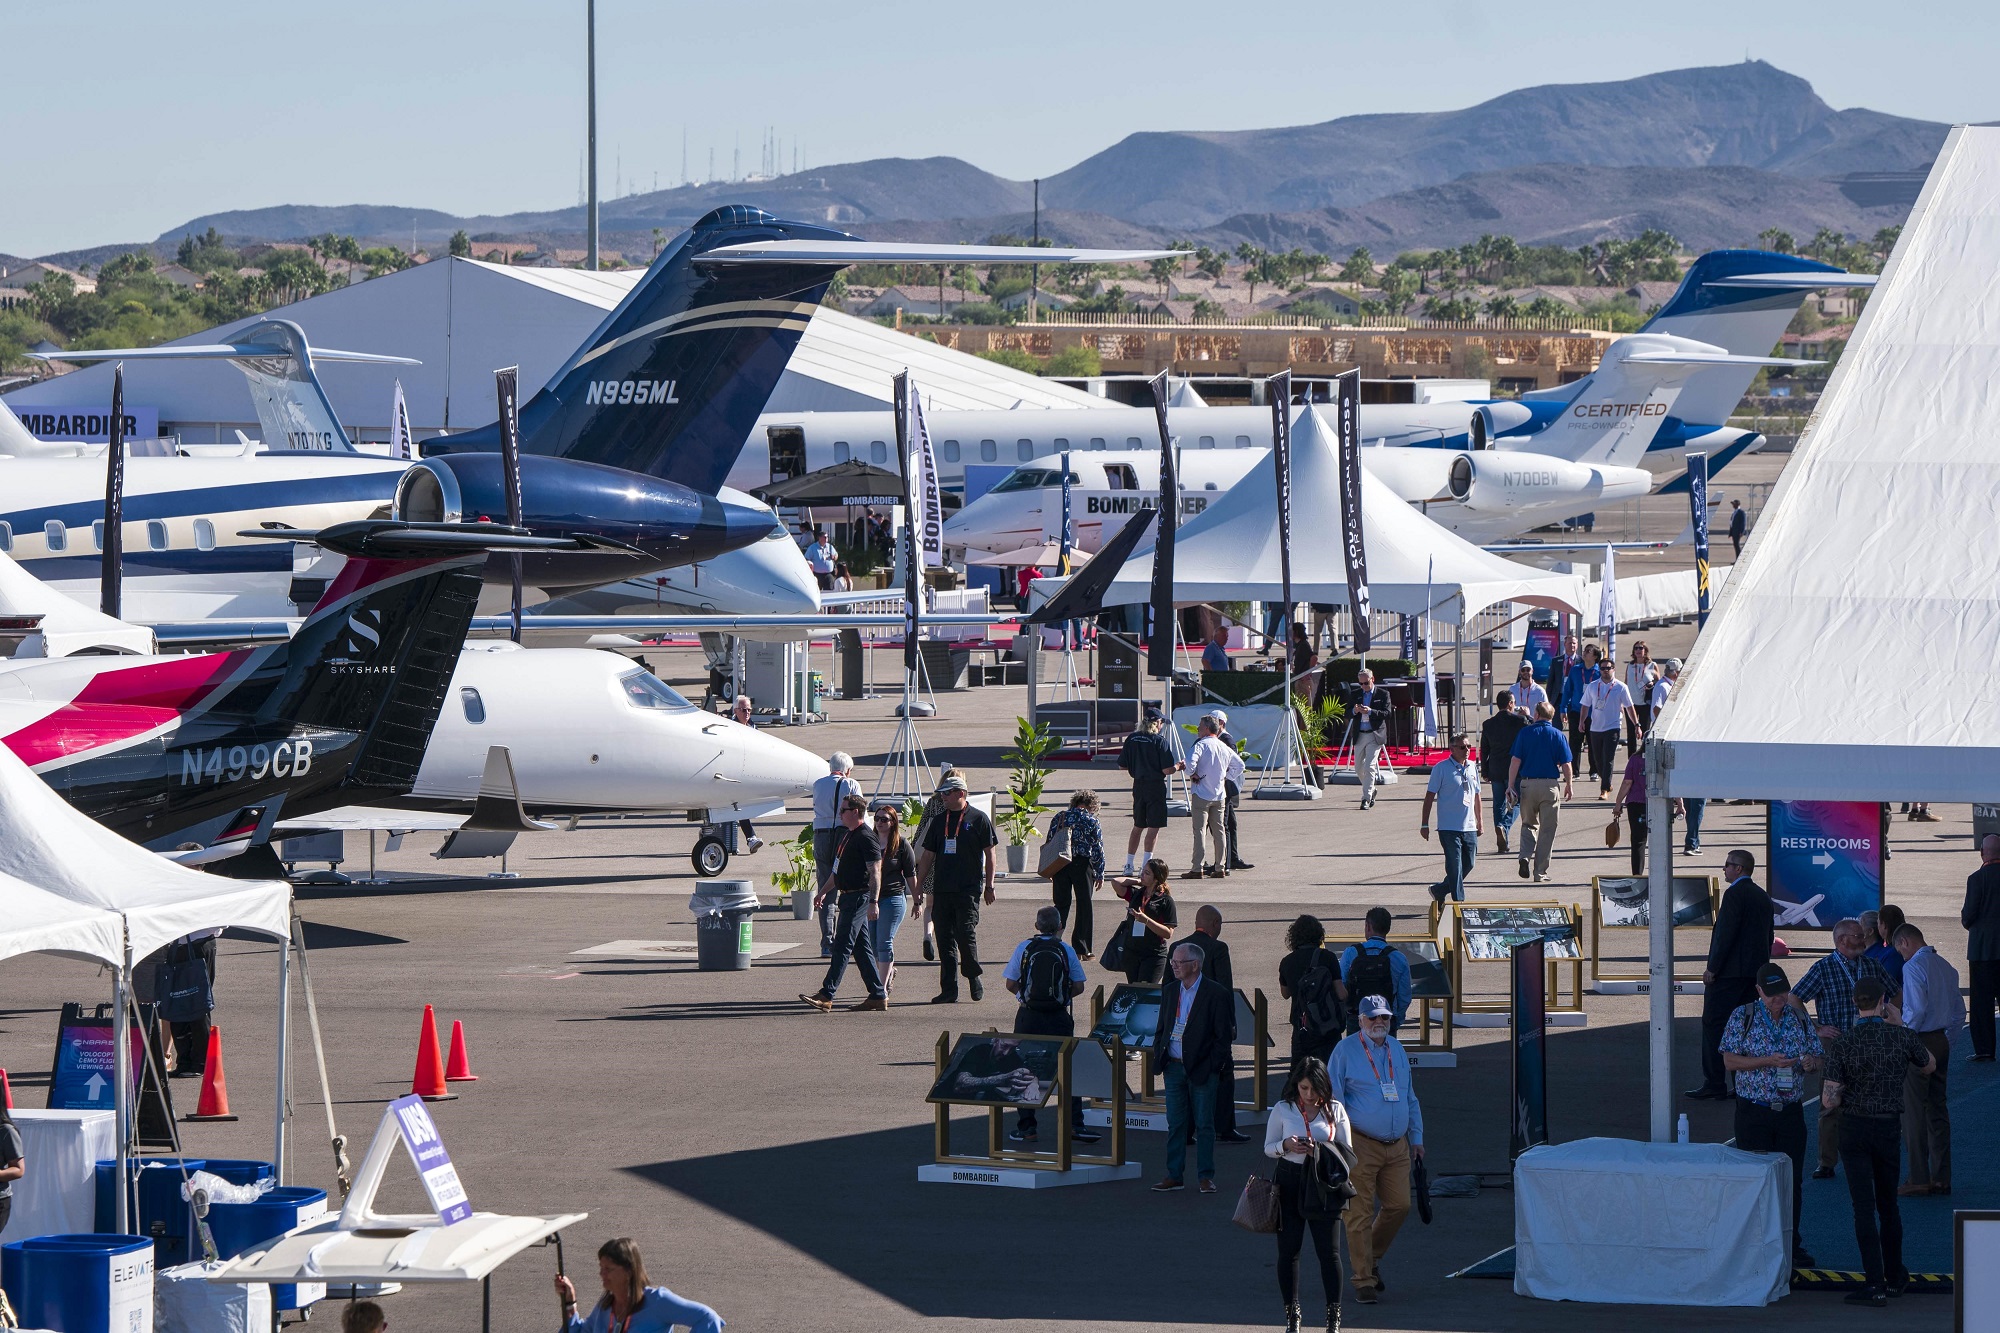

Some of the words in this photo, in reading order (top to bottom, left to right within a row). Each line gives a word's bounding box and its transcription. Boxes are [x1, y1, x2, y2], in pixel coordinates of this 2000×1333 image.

[586, 381, 679, 405] N995ML
[1574, 403, 1667, 417] CERTIFIED
[20, 414, 137, 436] MBARDIR
[1567, 421, 1627, 430] PRE-OWNED
[287, 431, 333, 451] N707KG
[1503, 471, 1559, 487] N700BW
[842, 496, 899, 506] BOMBARDIER
[330, 665, 397, 674] SKYSHARE
[181, 740, 314, 786] N499CB
[1780, 837, 1871, 850] RESTROOMS
[1106, 1116, 1149, 1128] BARDIER
[952, 1171, 999, 1183] BOMBARDIER
[114, 1260, 153, 1283] ELEVATE
